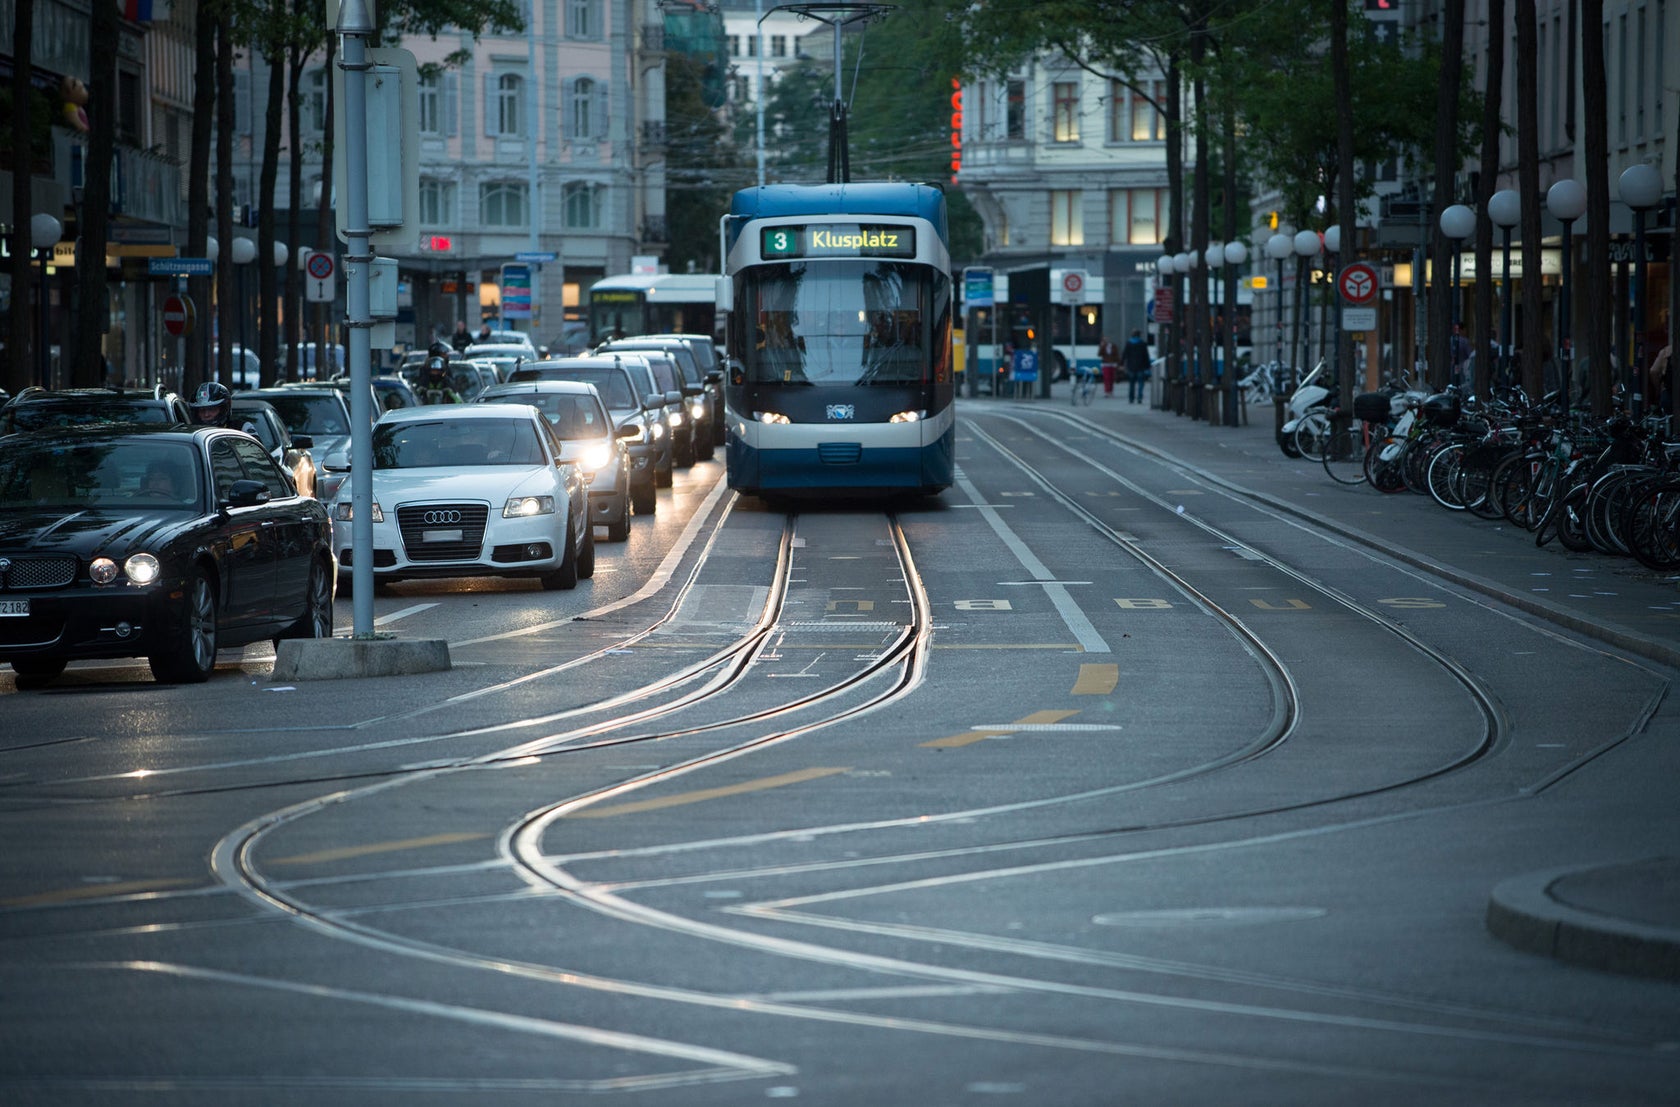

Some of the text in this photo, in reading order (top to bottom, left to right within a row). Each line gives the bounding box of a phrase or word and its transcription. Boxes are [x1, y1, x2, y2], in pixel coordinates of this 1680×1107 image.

[774, 230, 898, 250] 3 Klusplatz
[151, 260, 210, 273] Schützengasse
[0, 602, 28, 614] 2182
